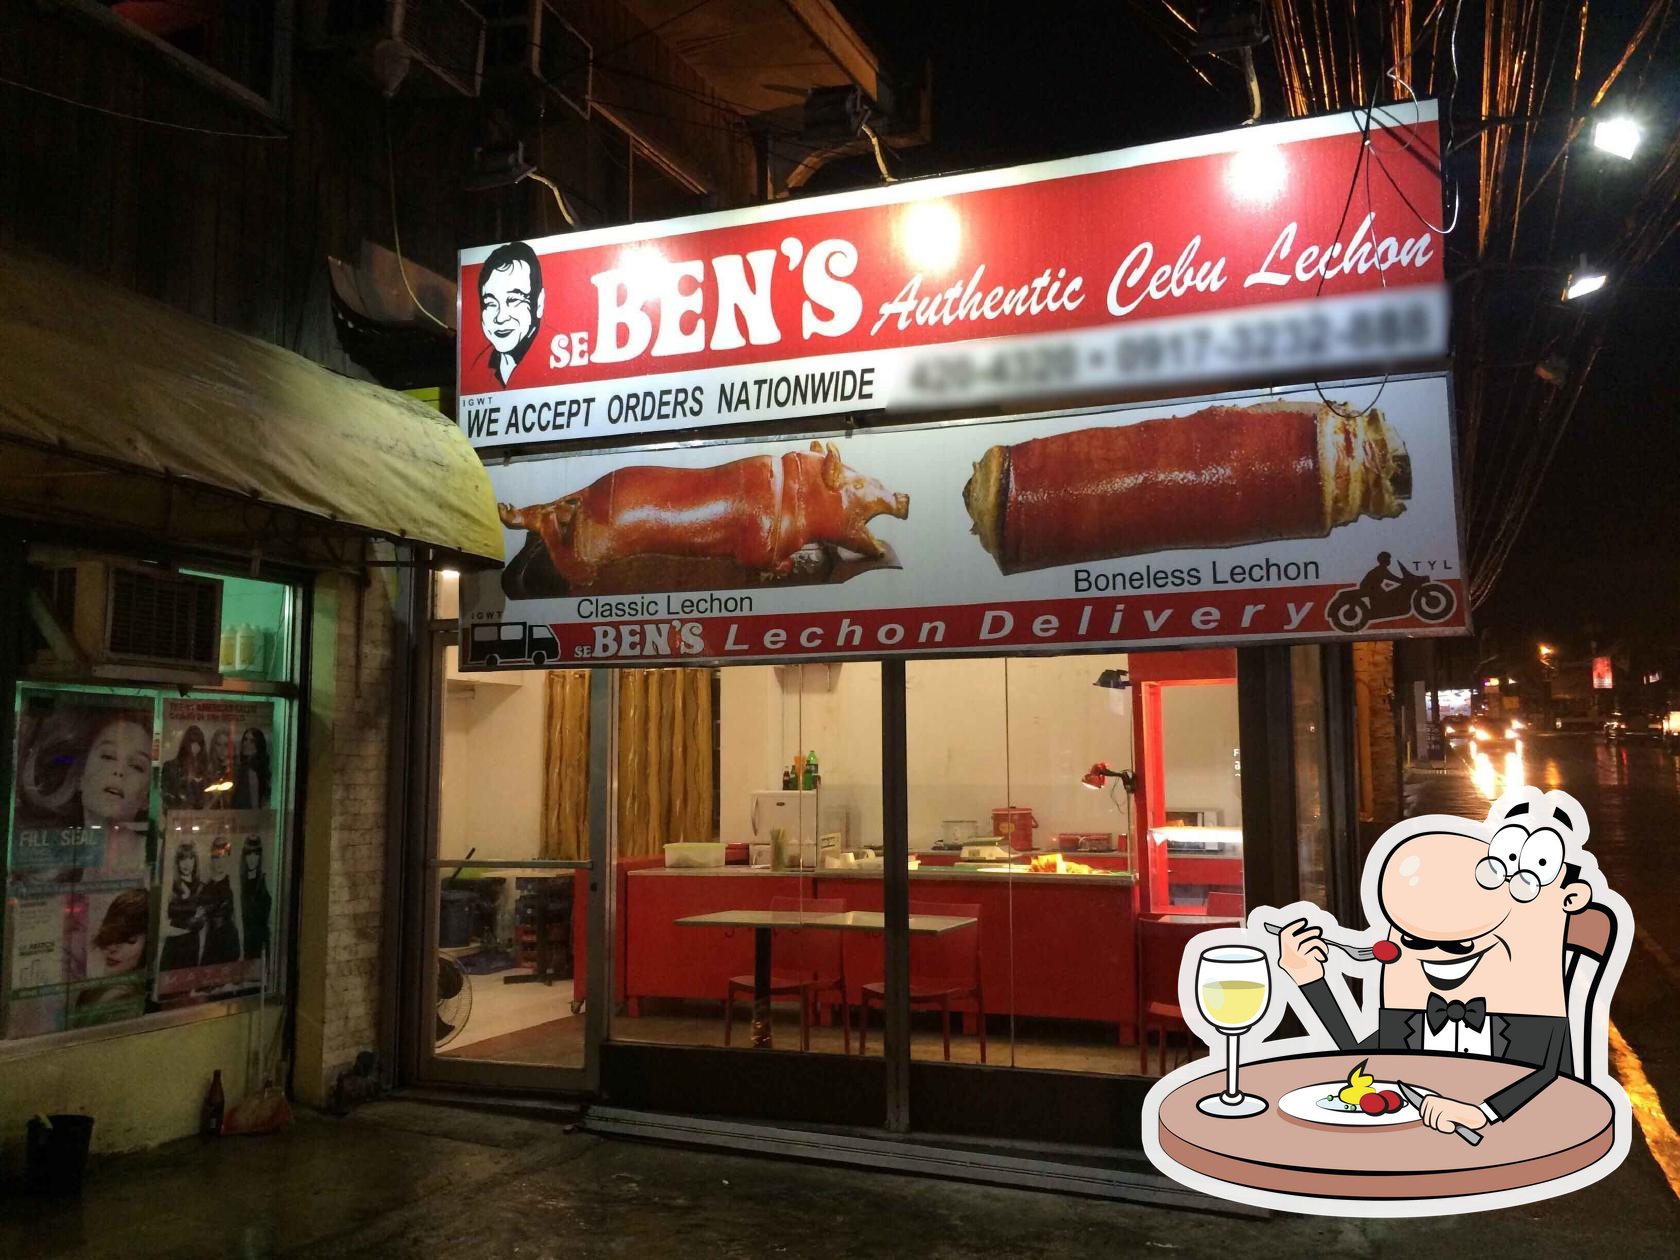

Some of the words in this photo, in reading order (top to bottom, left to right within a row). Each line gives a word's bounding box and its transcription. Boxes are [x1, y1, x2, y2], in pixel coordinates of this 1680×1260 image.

[870, 264, 1084, 336] Authentic
[1106, 234, 1227, 317] Cebu
[1244, 211, 1434, 288] Lechon
[467, 407, 501, 438] WE
[504, 397, 595, 435] ACCEPT
[607, 385, 704, 425] ORDERS
[717, 367, 875, 414] NATIONWIDE
[1074, 567, 1202, 593] Boneless
[1213, 557, 1320, 586] Lechon
[576, 596, 659, 620] Classic
[666, 593, 754, 616] Lechon
[724, 618, 947, 652] Lechon
[979, 600, 1316, 640] Delivery
